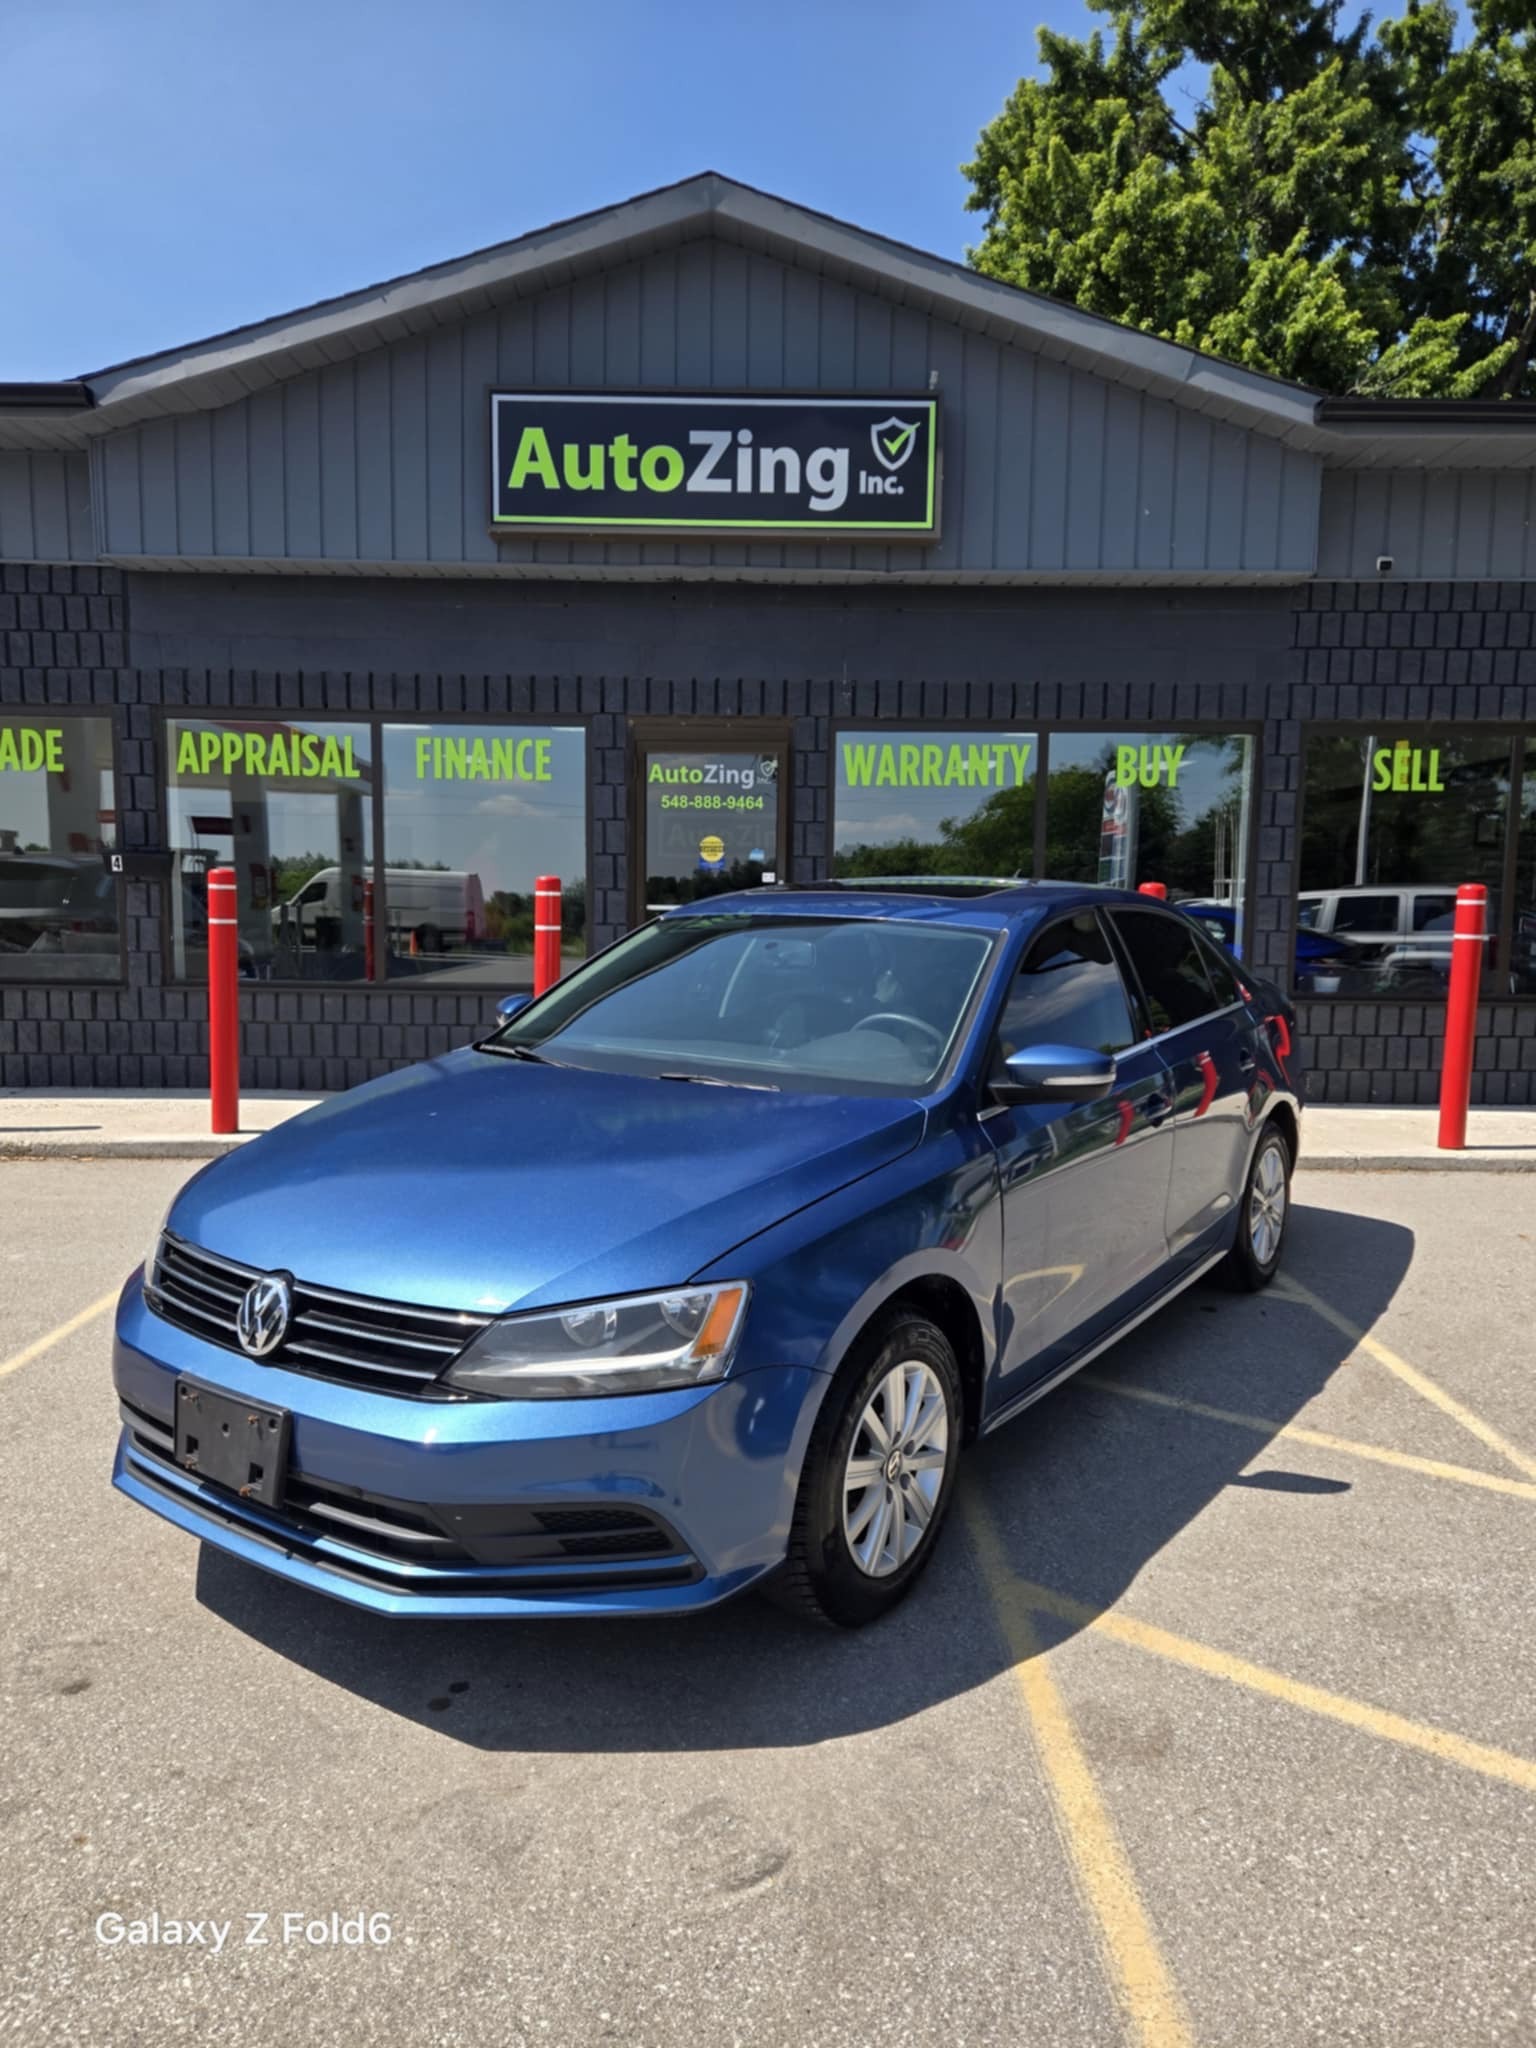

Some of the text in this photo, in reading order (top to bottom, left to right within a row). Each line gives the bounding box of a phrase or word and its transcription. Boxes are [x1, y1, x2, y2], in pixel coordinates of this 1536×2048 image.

[507, 426, 904, 512] AutoZing Inc.
[176, 731, 360, 778] APPRAISAL
[415, 736, 552, 781] FINANCE
[648, 764, 755, 789] AutoZing
[843, 743, 1031, 787] WARRANTY
[1116, 744, 1184, 788] BUY
[1372, 748, 1444, 792] SELL
[661, 795, 763, 809] 548-888-9464
